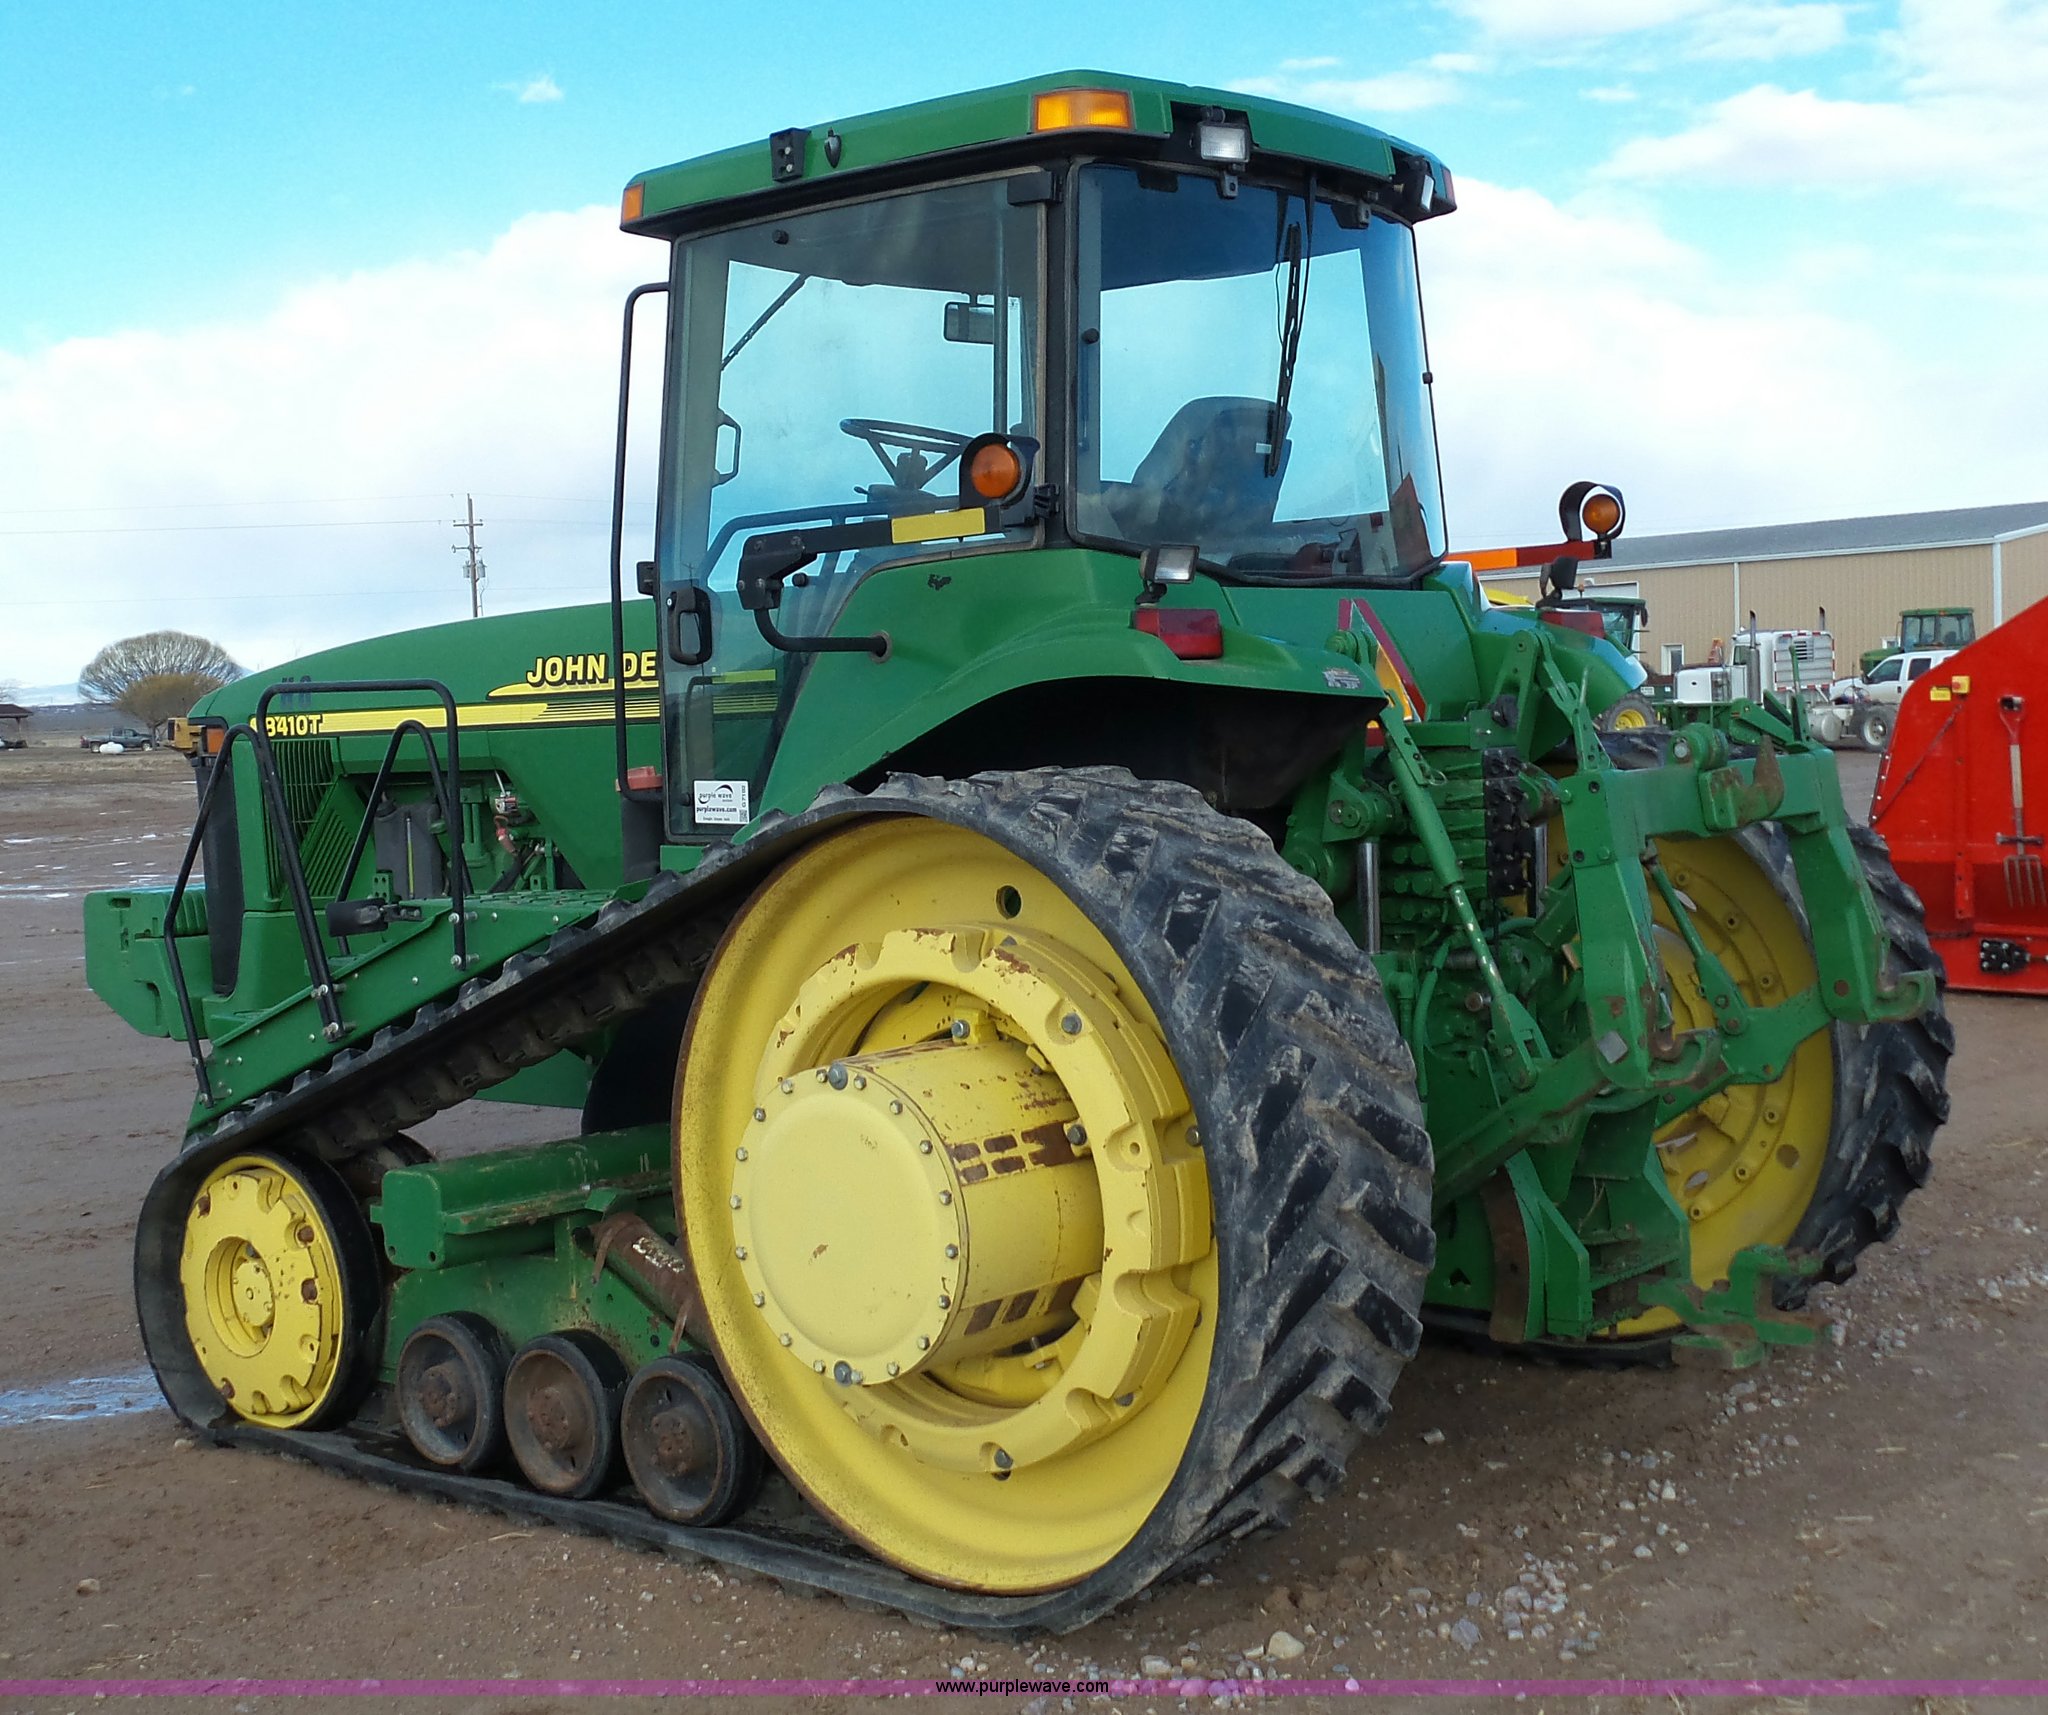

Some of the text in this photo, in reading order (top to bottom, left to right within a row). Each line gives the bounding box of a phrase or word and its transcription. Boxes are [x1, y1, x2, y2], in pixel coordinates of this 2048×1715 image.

[526, 654, 607, 687] JOHN
[264, 714, 321, 737] 8410T
[696, 805, 738, 813] purplewave.com
